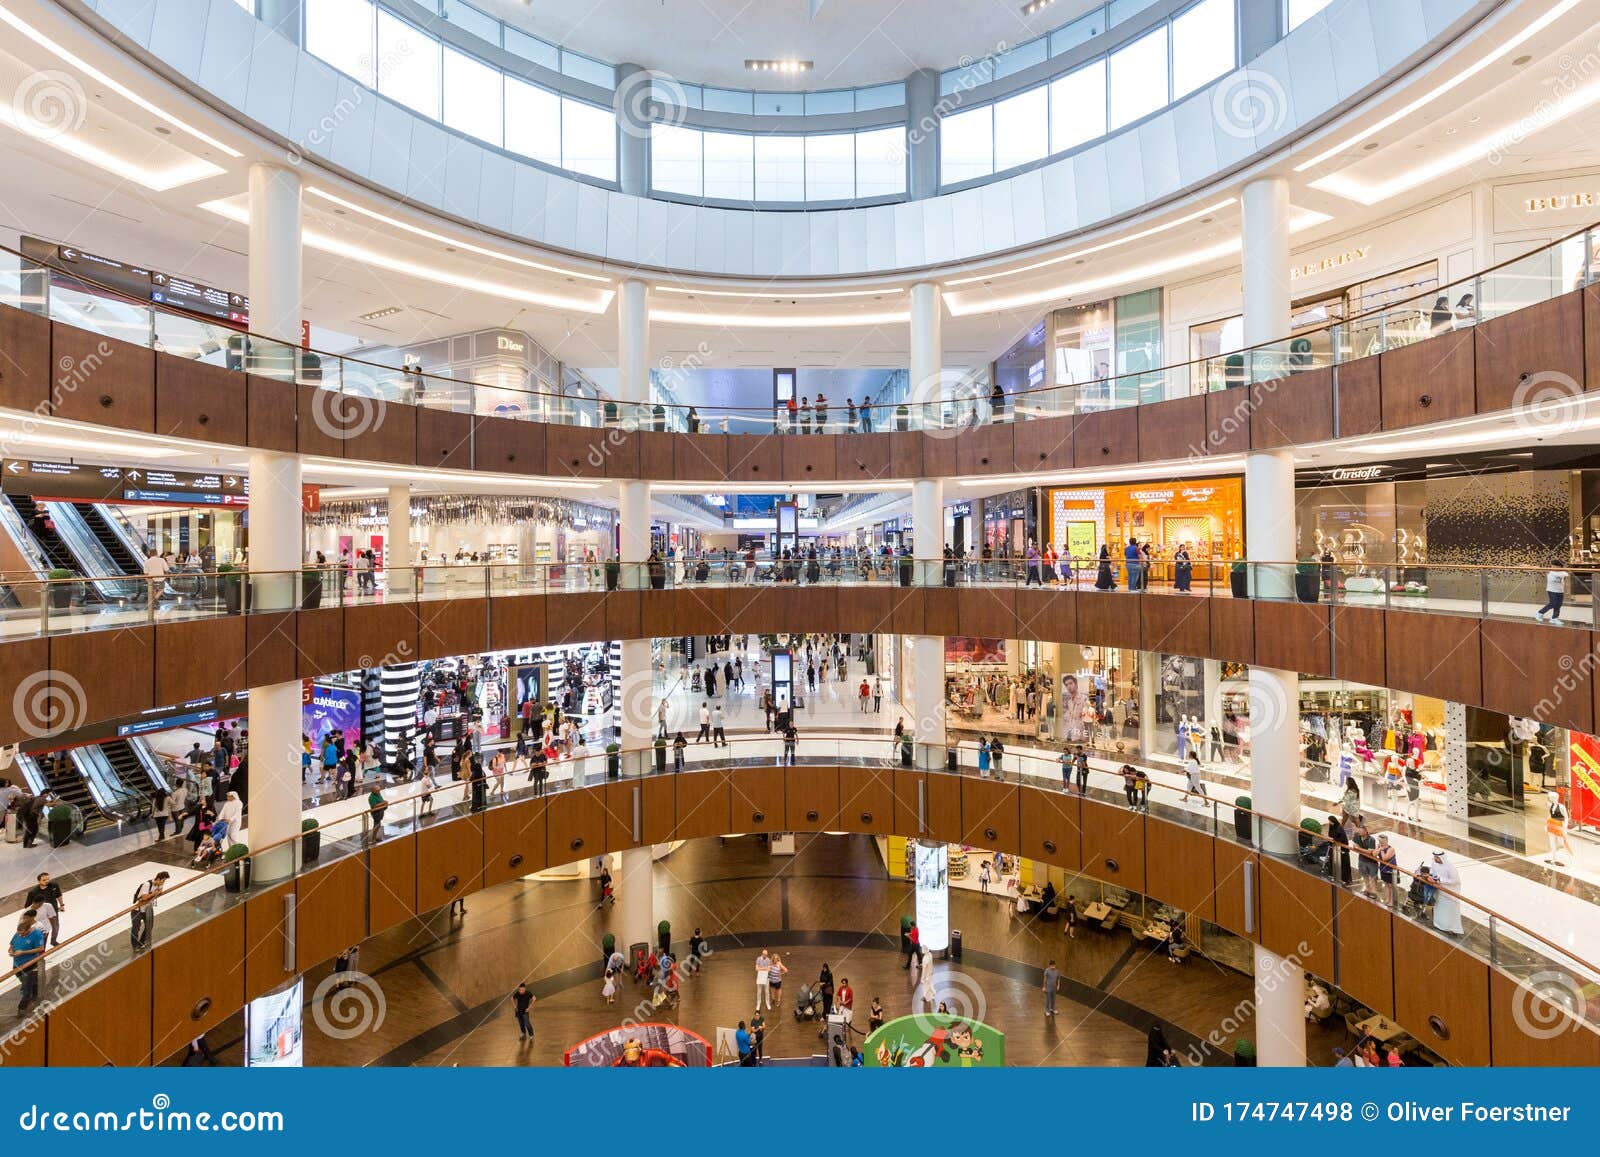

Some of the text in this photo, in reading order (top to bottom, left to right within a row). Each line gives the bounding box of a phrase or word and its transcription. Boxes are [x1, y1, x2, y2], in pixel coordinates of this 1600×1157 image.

[1526, 192, 1600, 213] BUR
[1290, 246, 1370, 281] BERRY
[498, 336, 524, 352] Dior
[1332, 466, 1382, 480] Christofle
[128, 491, 135, 499] P
[225, 495, 232, 503] P
[121, 726, 129, 735] P
